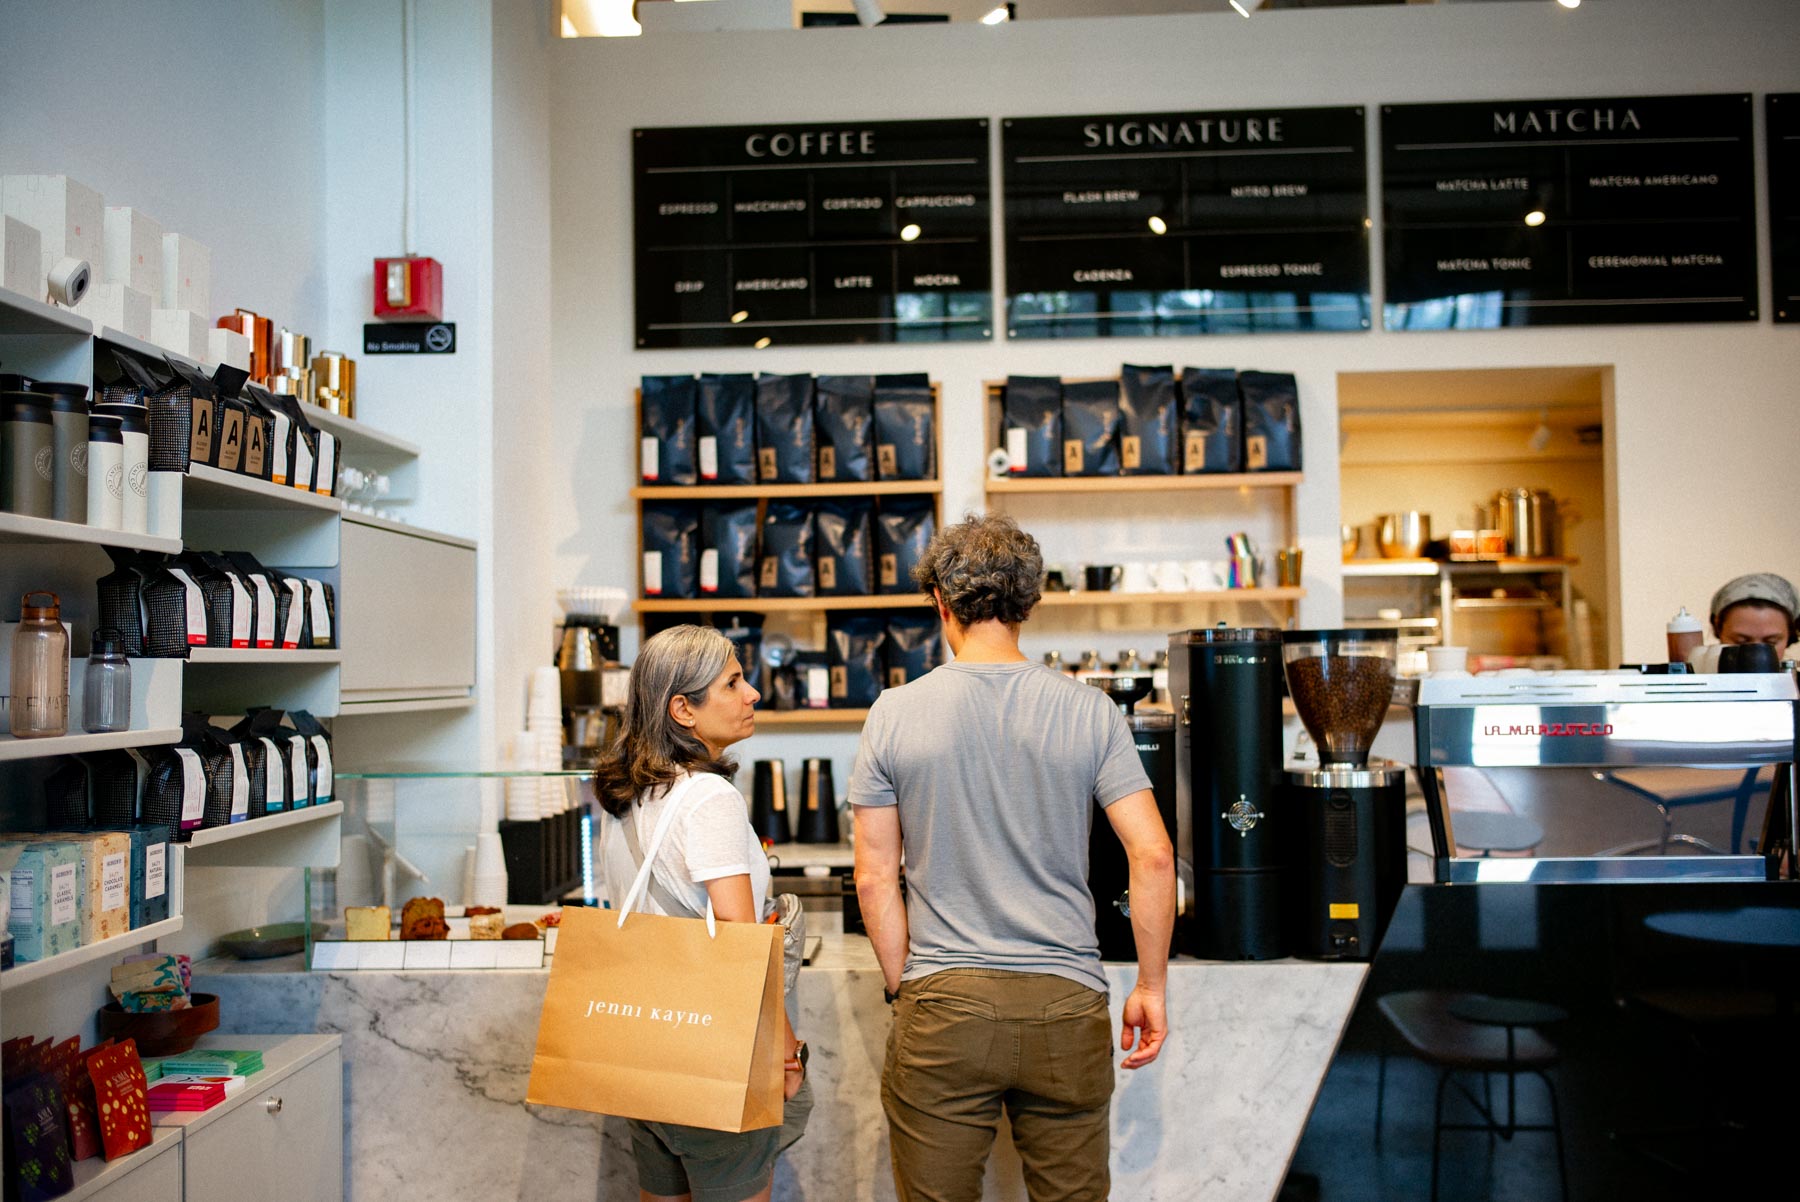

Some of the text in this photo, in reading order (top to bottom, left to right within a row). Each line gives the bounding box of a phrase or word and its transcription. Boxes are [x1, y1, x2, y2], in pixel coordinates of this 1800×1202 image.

[1494, 109, 1640, 133] MATCHA
[1084, 117, 1283, 147] SIGNATURE
[745, 131, 875, 158] COFFEE
[1437, 178, 1528, 191] MATCHA LATTE
[1590, 175, 1718, 186] MATCHA AMERICANO
[1063, 191, 1139, 203] FLASH BREW
[1231, 185, 1307, 197] NITRO BREW
[735, 200, 806, 212] MACCHIATO
[823, 198, 882, 210] CORTADO
[896, 196, 975, 208] CAPPUCCINO
[659, 203, 718, 215] ESPRESSO
[1437, 258, 1530, 270] MATCHA TONIC
[1589, 255, 1722, 268] CEREMONIAL MATCHA
[1074, 269, 1132, 282] CADENZA
[1220, 263, 1321, 277] ESPRESSO TONIC
[675, 281, 704, 292] DRIP
[736, 278, 807, 290] AMERICANO
[835, 276, 872, 288] LATTE
[914, 275, 960, 286] MOCHA
[367, 341, 420, 352] No Smoking
[198, 410, 208, 437] A
[227, 420, 238, 446] A
[251, 426, 261, 451] A
[1136, 743, 1160, 751] NELLI
[104, 876, 123, 886] CHOCOLATE
